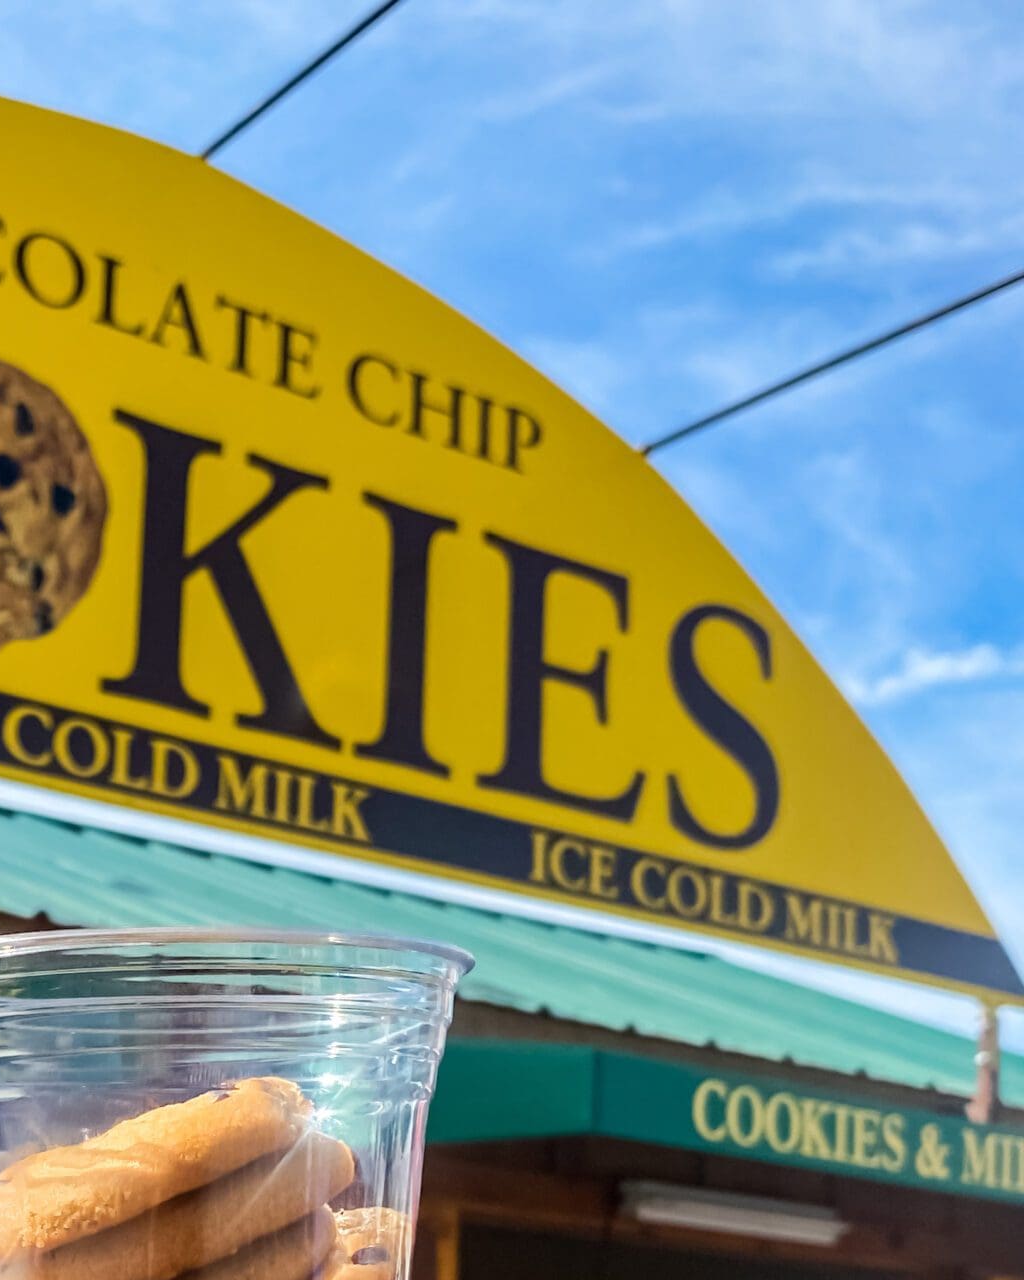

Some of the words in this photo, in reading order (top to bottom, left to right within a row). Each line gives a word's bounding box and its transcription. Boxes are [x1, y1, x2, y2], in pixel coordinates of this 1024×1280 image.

[345, 352, 545, 474] CHIP
[1, 705, 201, 799] COLD
[213, 754, 372, 844] MILK
[529, 831, 618, 899] ICE
[630, 857, 773, 932] COLD
[785, 891, 899, 966] MILK
[692, 1078, 906, 1173] COOKIES
[914, 1123, 952, 1179] &
[960, 1126, 1024, 1194] MI
